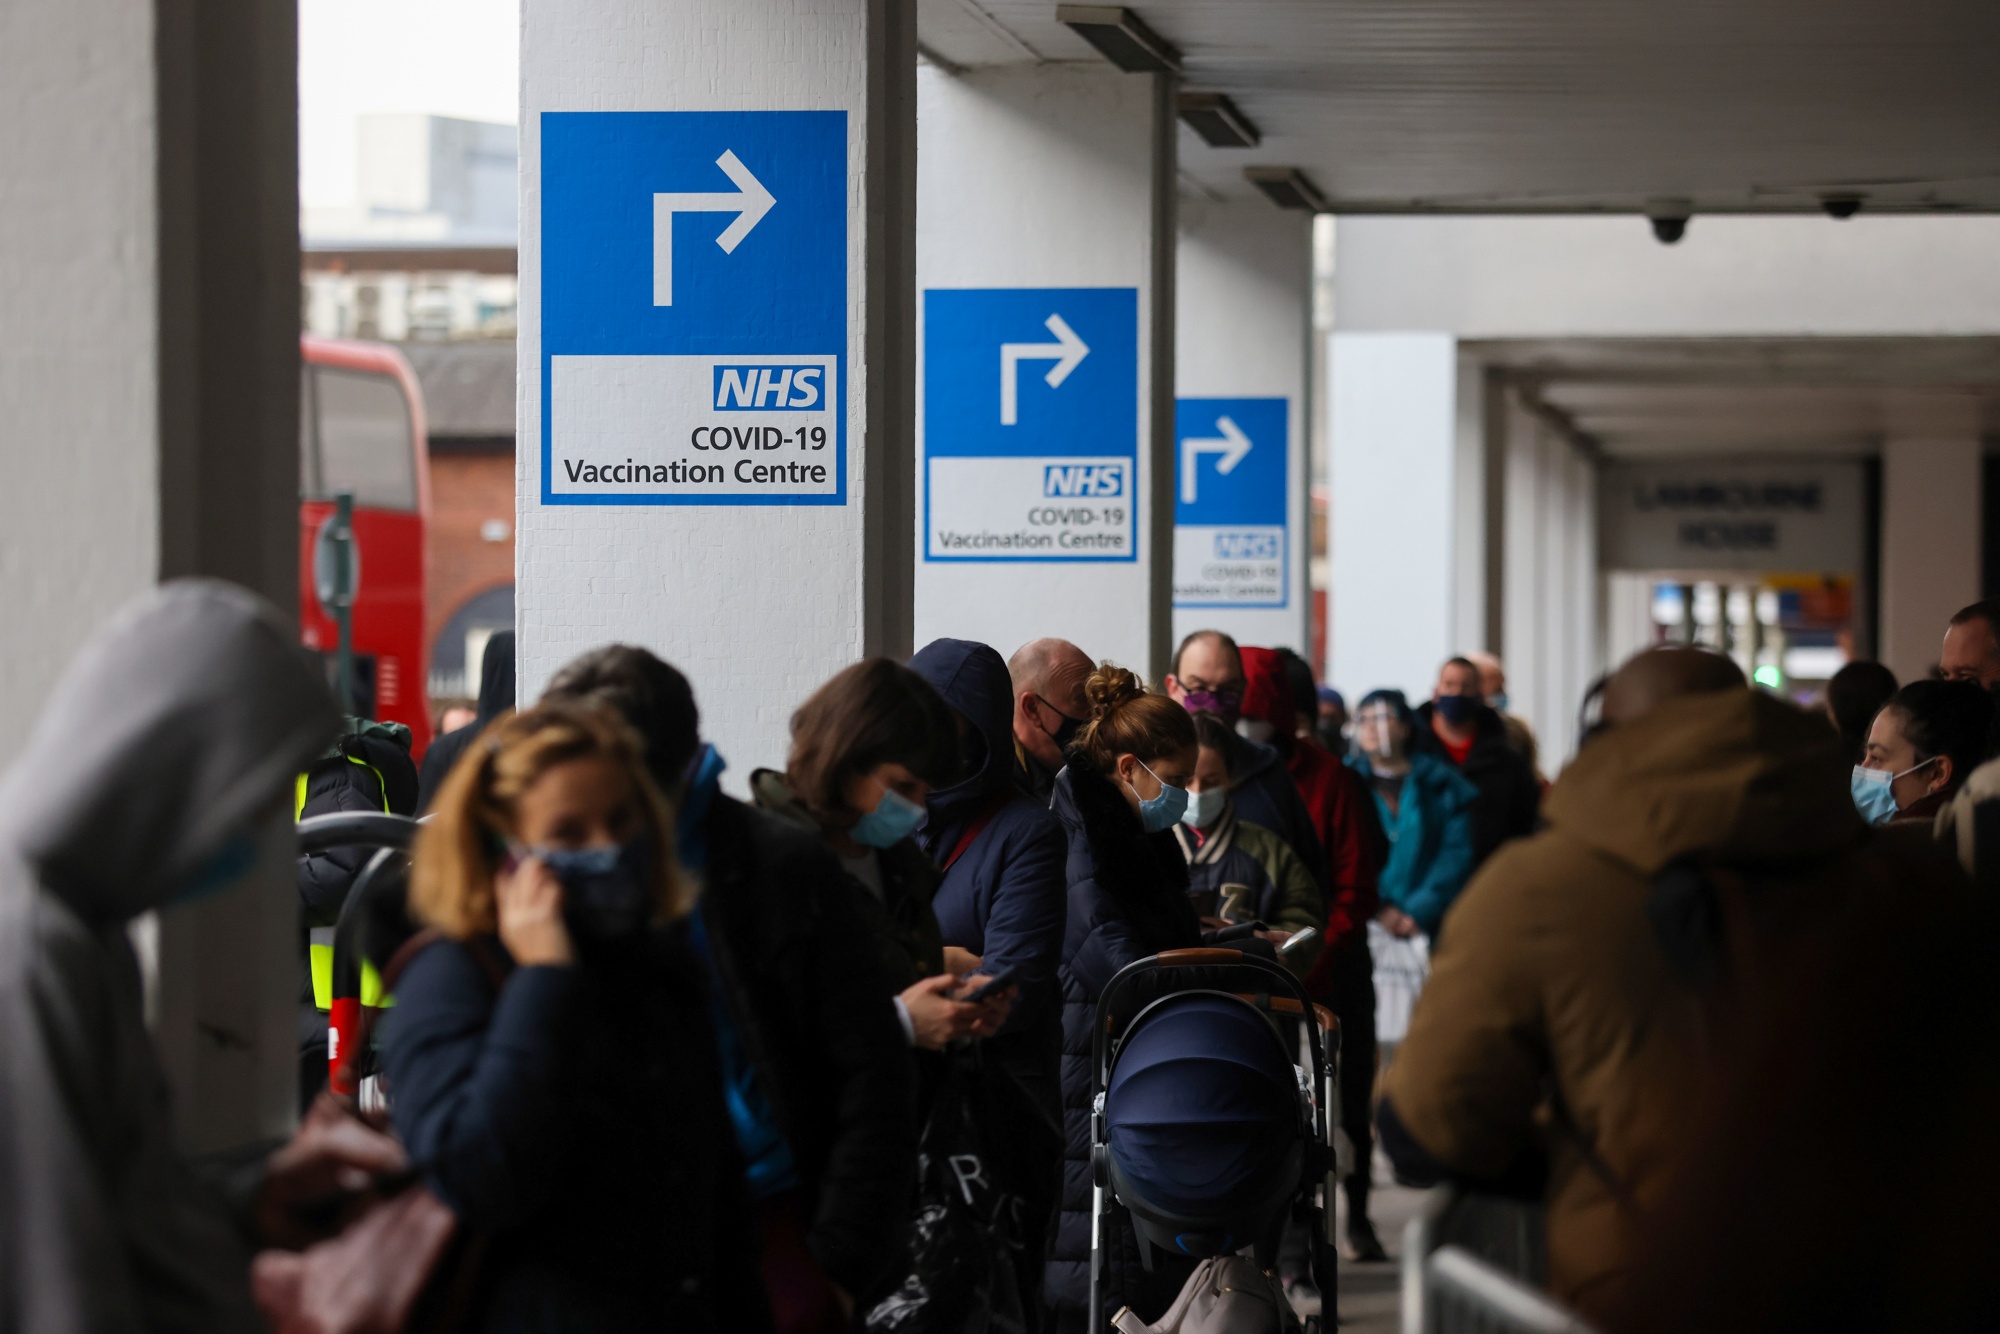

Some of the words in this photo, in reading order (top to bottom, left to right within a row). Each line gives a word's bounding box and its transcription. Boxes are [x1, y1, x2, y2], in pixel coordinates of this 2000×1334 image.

[716, 368, 822, 408] NHS
[691, 426, 827, 451] COVID-19
[564, 458, 724, 483] Vaccination
[734, 459, 827, 483] Centre
[1046, 467, 1121, 496] NHS
[1027, 506, 1125, 526] COVID-19
[939, 530, 1053, 549] Vaccination
[1058, 531, 1125, 549] Centre
[1216, 534, 1275, 558] NHS
